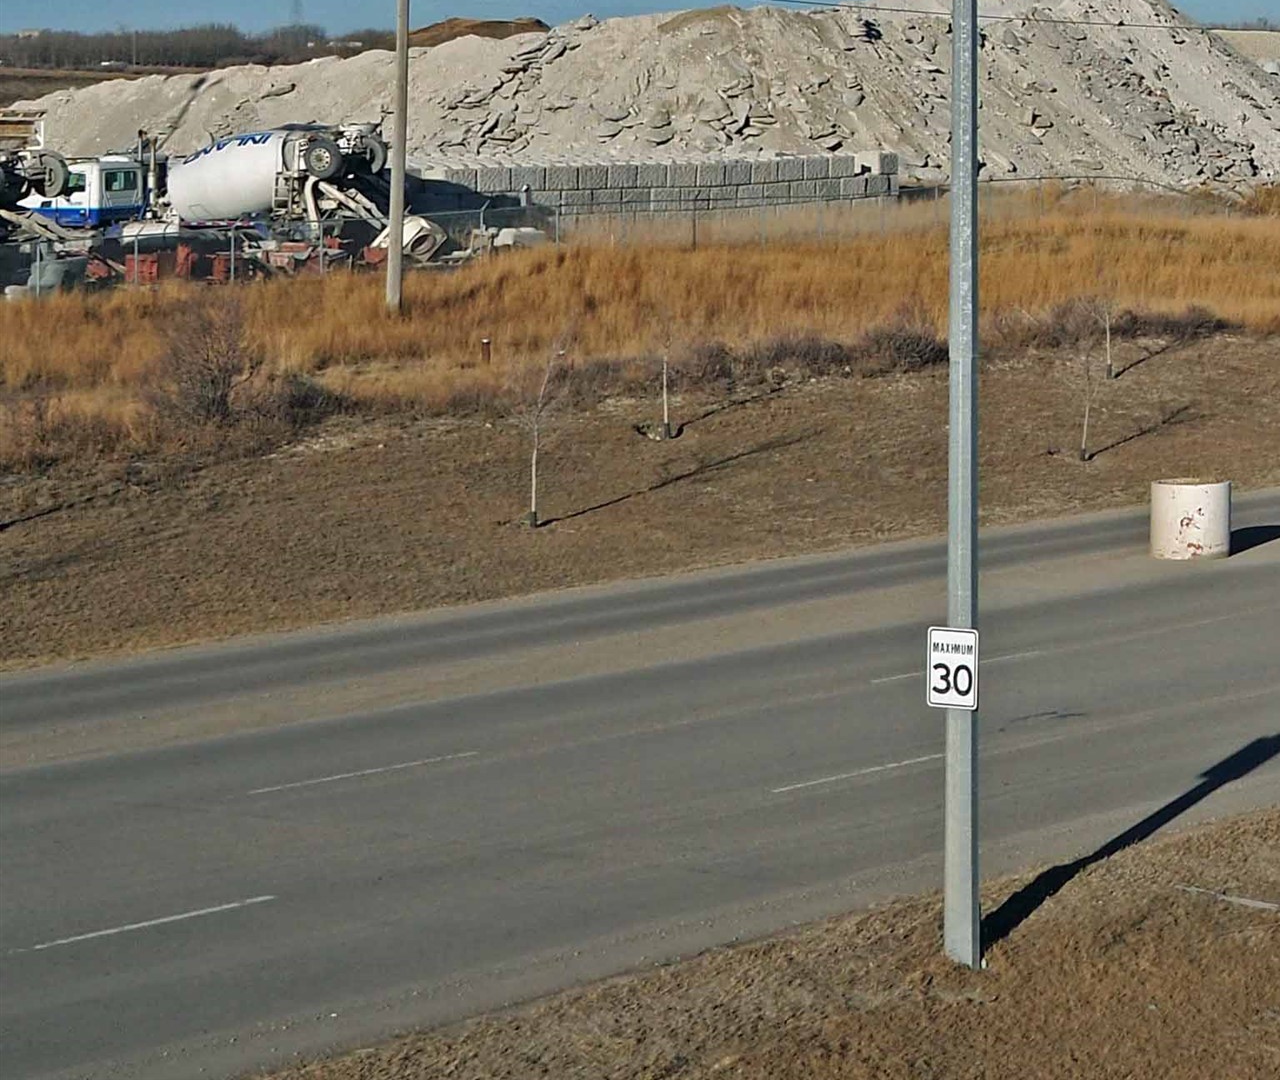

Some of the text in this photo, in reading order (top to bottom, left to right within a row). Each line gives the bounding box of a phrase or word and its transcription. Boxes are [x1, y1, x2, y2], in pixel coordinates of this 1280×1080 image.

[183, 133, 274, 165] INLAND
[933, 641, 974, 655] MAXIMUM
[932, 662, 974, 697] 30
